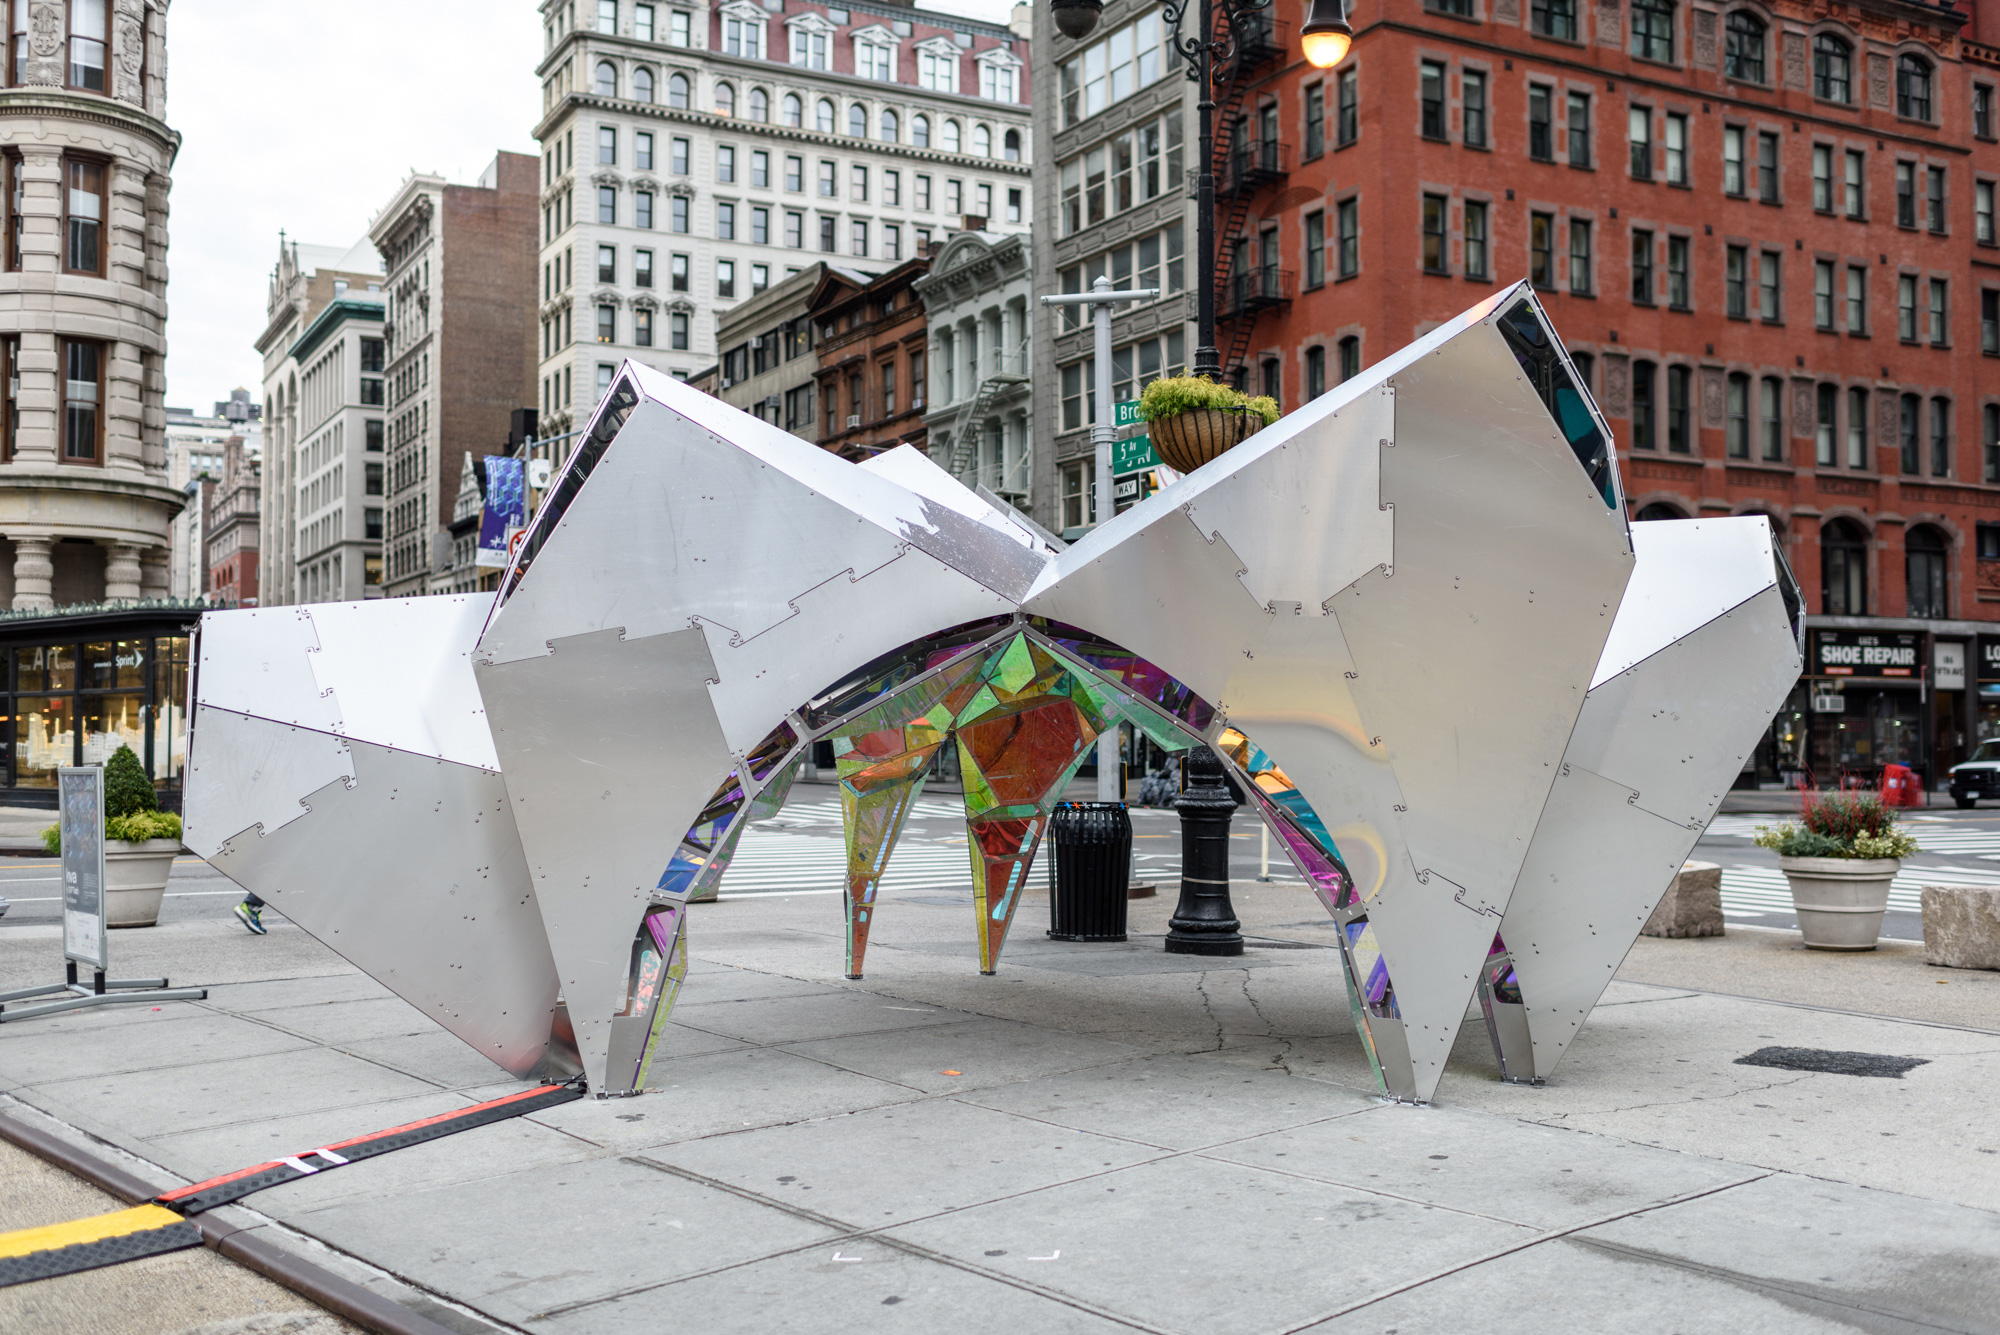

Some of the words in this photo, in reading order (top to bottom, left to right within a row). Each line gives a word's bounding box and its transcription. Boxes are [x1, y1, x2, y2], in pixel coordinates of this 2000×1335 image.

[1121, 443, 1126, 460] 5
[1118, 483, 1134, 496] WAY
[115, 654, 135, 669] Sprint
[1821, 645, 1862, 664] SHOE
[1863, 646, 1915, 665] REPAIR
